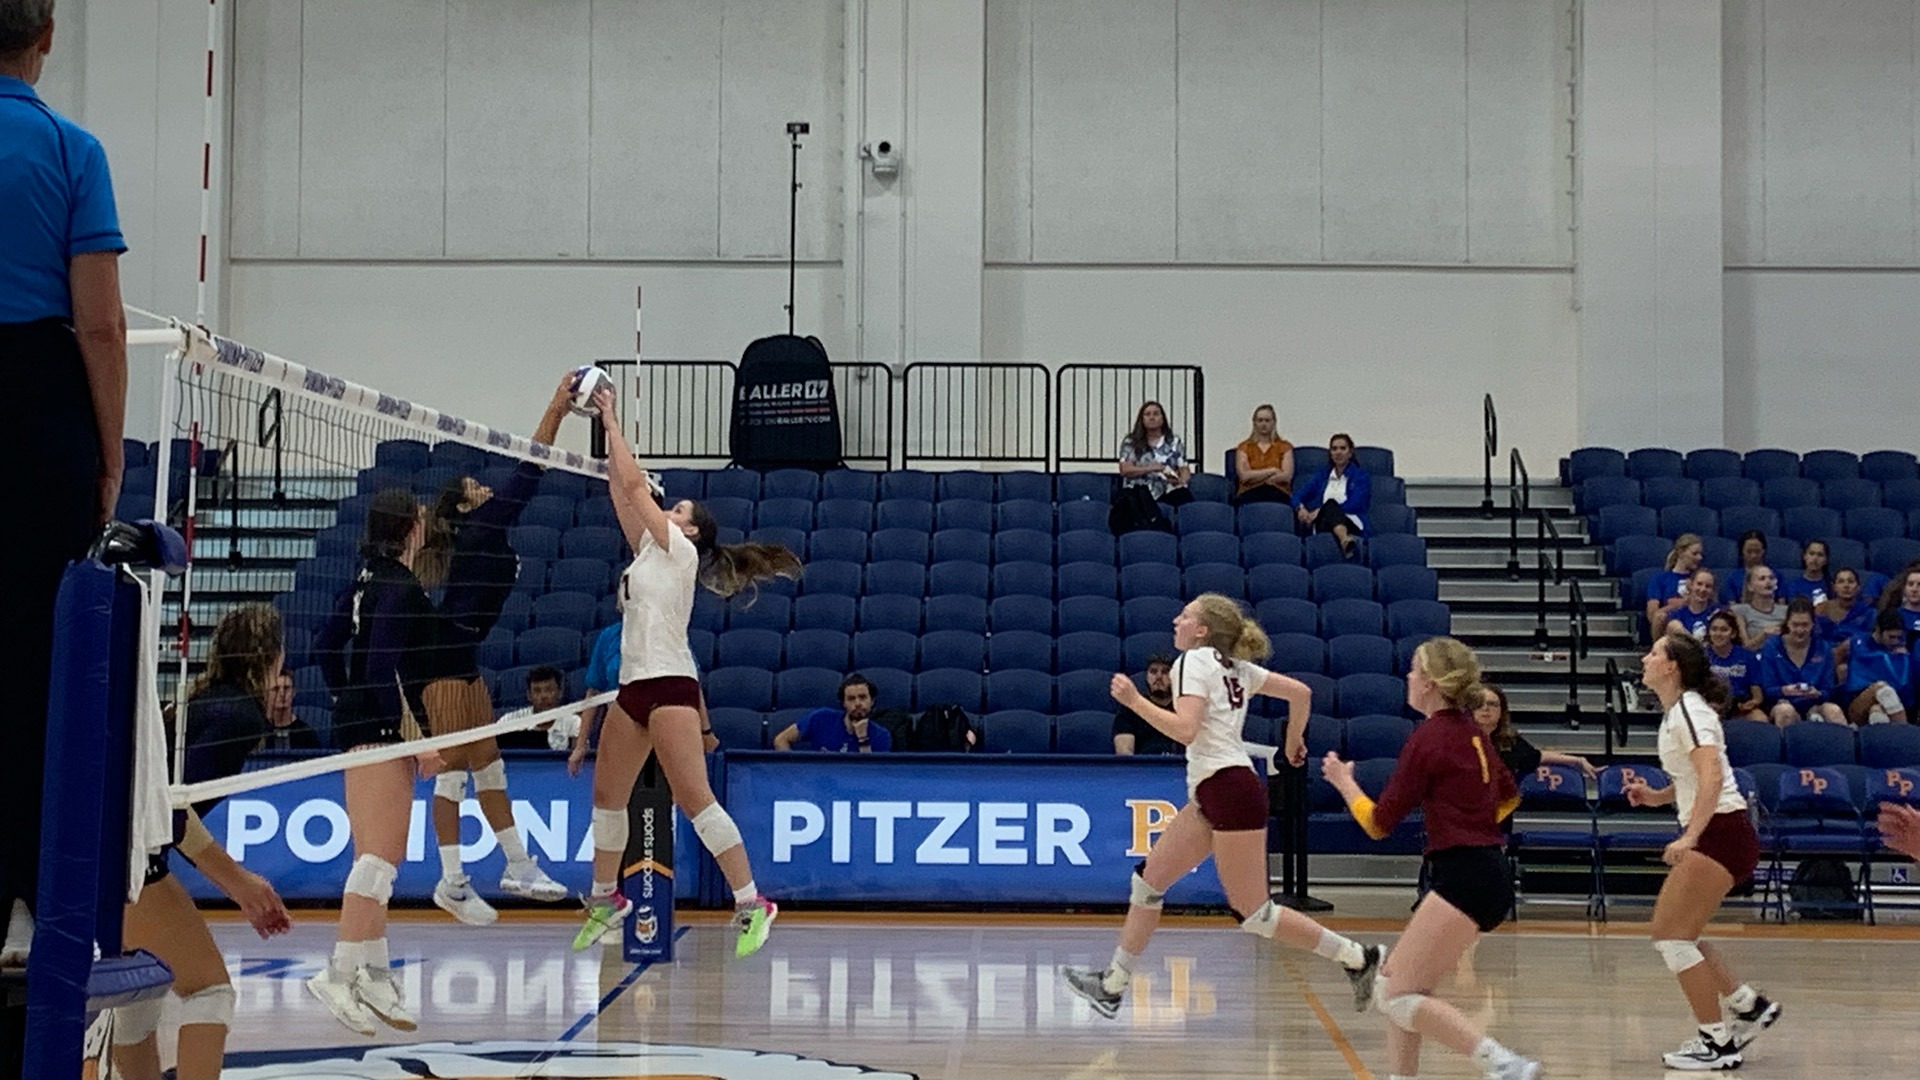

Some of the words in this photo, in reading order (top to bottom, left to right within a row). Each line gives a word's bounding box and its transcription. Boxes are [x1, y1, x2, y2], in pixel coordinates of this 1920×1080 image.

[1472, 736, 1490, 784] 1
[1800, 769, 1828, 795] PP
[1886, 769, 1914, 796] PP
[226, 799, 595, 863] POON
[642, 808, 654, 848] sports
[773, 800, 1092, 866] PITZER
[1125, 799, 1180, 857] P
